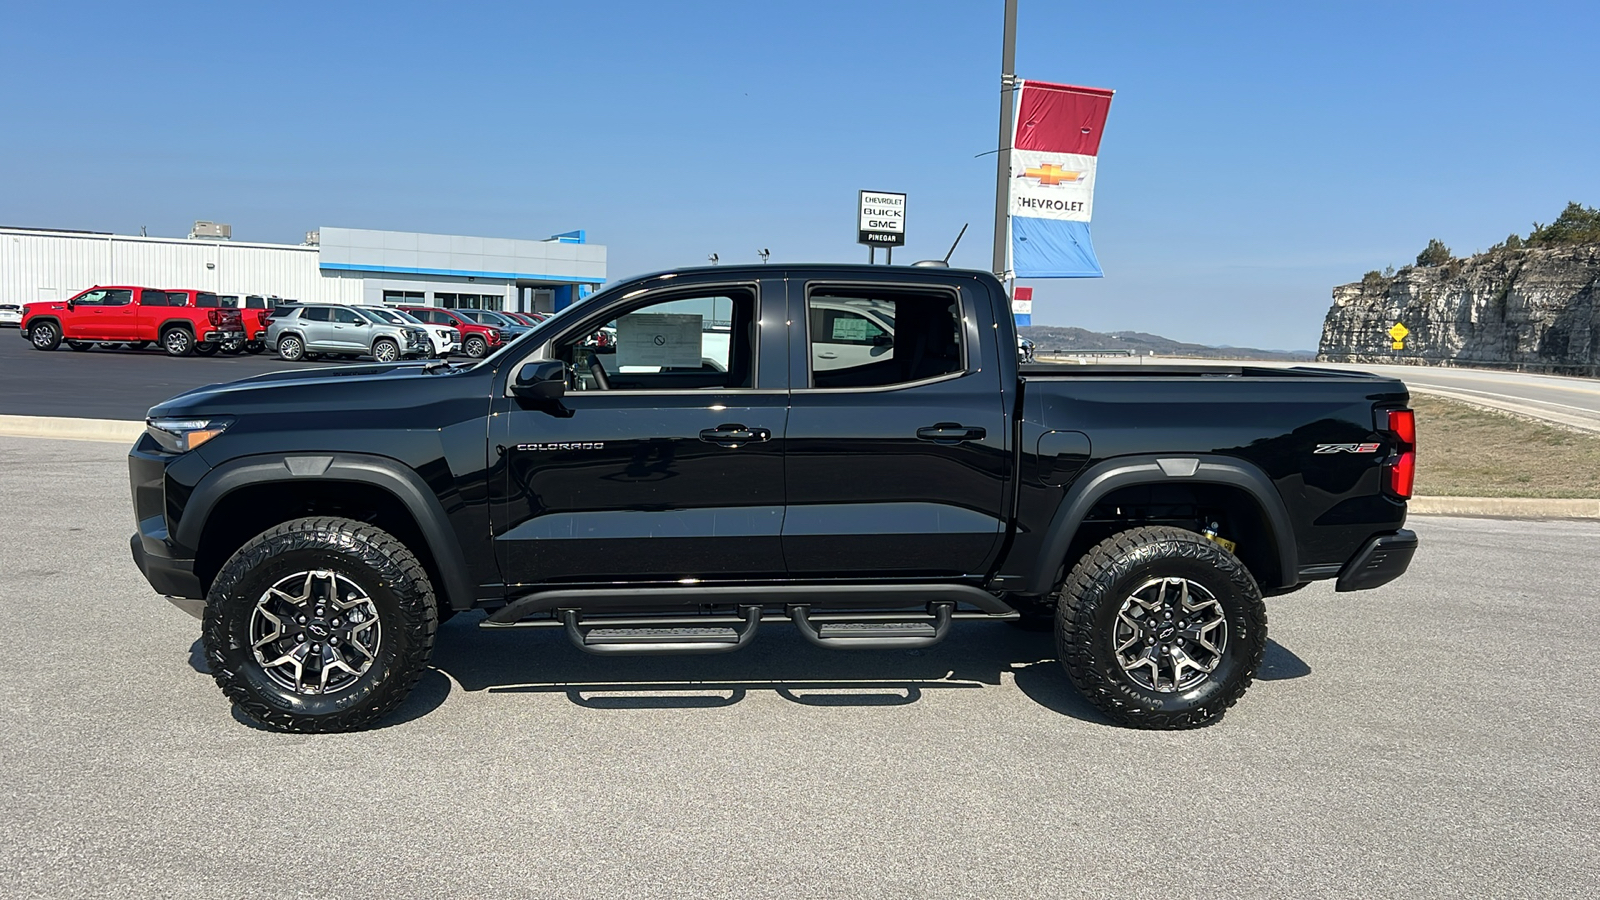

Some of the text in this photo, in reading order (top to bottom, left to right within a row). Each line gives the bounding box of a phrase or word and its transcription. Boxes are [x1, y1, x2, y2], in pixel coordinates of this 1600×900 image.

[865, 196, 902, 205] CHEVROLET
[864, 208, 902, 217] BUICK
[868, 220, 897, 229] GMC
[868, 233, 896, 242] PINEGAR
[517, 442, 604, 451] COLORADO
[1313, 442, 1381, 454] ZR2
